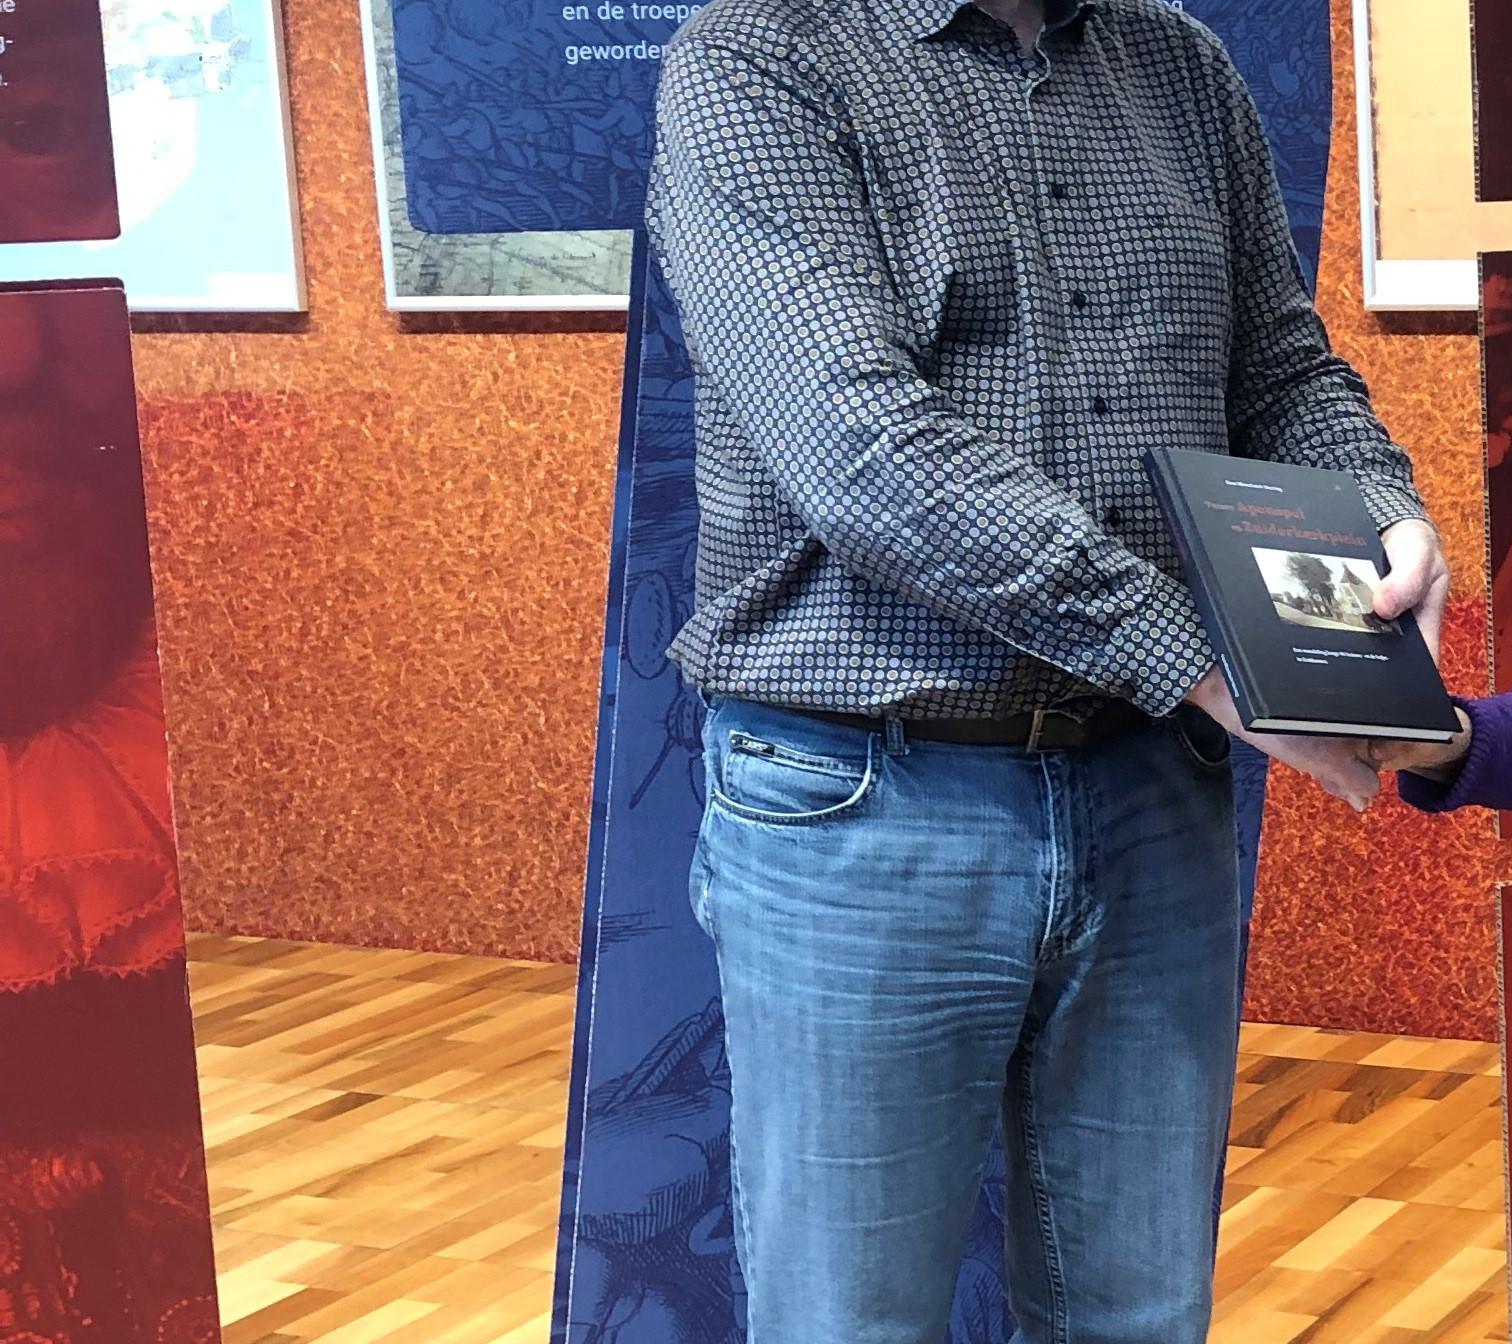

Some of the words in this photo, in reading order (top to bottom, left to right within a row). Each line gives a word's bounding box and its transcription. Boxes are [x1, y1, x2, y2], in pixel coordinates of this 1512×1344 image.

[563, 5, 589, 20] en
[597, 1, 625, 20] de
[631, 2, 703, 23] troepe
